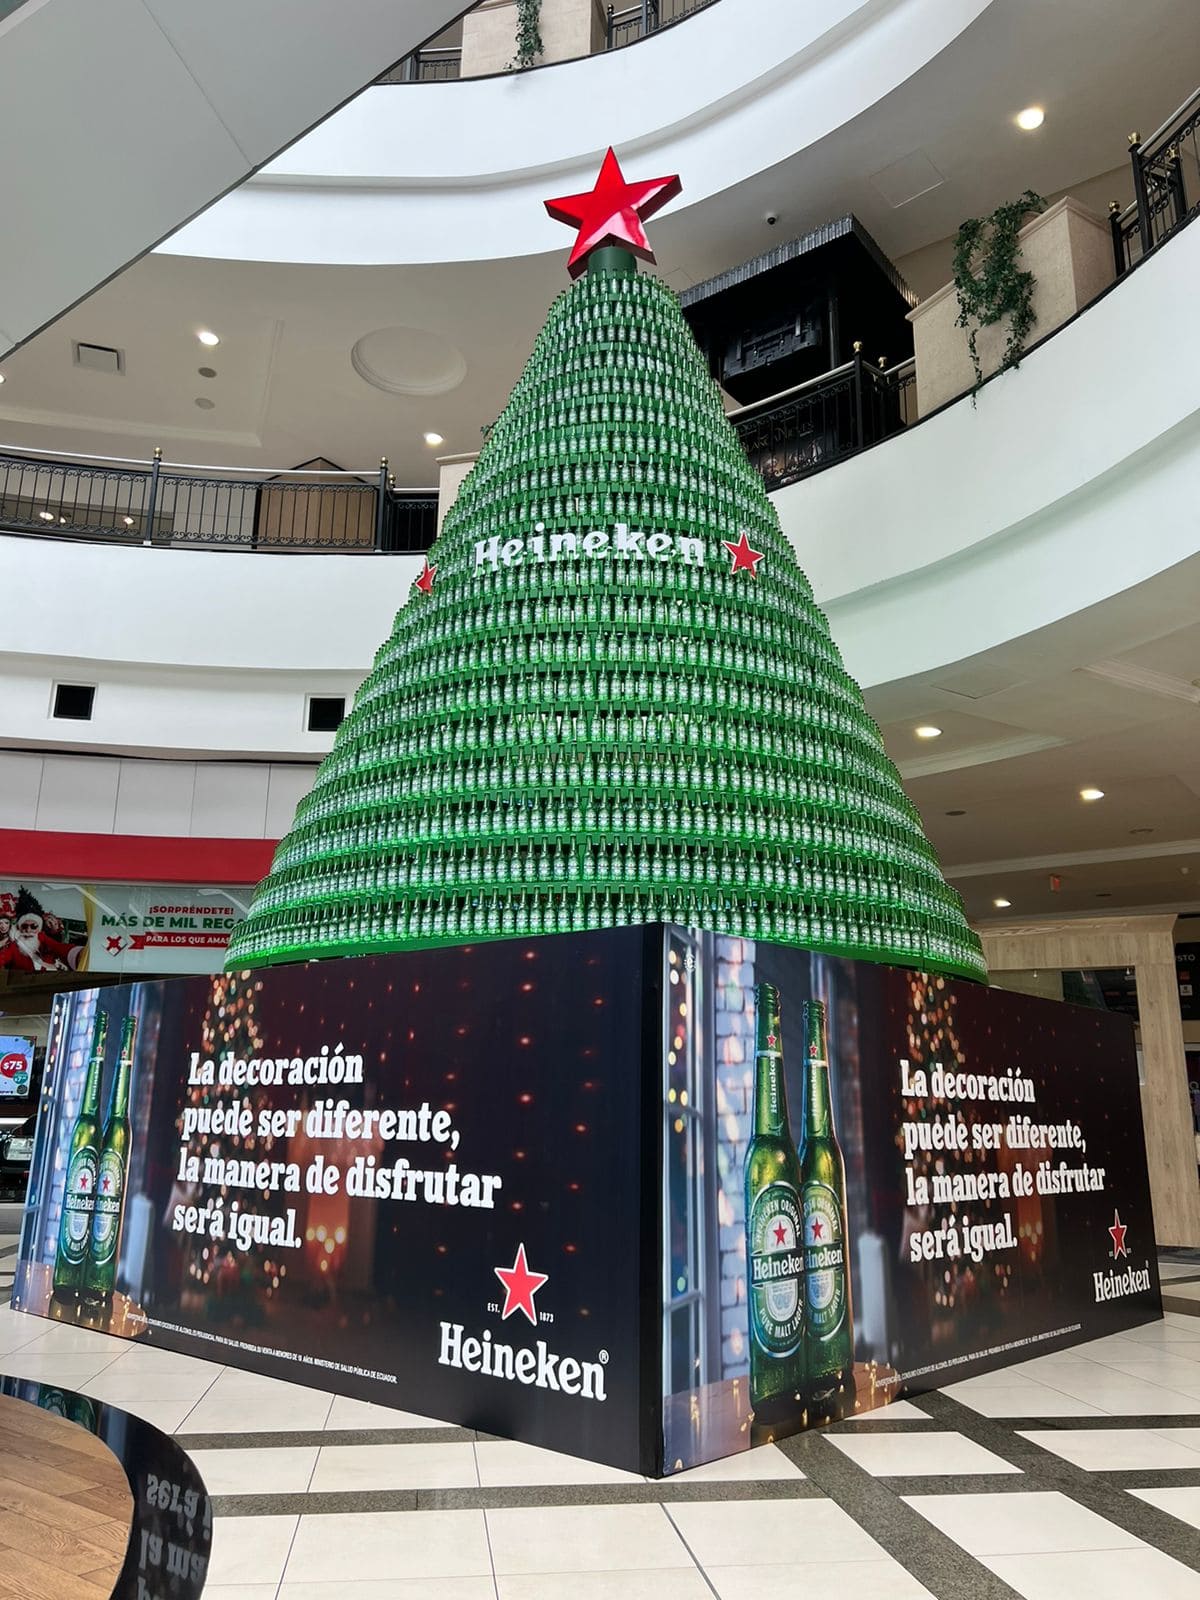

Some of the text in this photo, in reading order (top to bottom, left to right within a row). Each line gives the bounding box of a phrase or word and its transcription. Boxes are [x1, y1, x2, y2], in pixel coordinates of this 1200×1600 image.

[473, 522, 704, 577] Heineken
[101, 913, 138, 927] MÁS
[143, 916, 165, 928] DE
[170, 917, 198, 929] MIL
[146, 935, 168, 943] PARA
[170, 936, 187, 944] LOS
[188, 937, 205, 945] QUE
[3, 1060, 23, 1071] $75
[188, 1042, 363, 1086] La decoración
[900, 1059, 1036, 1103] La decoración
[181, 1098, 461, 1151] puede ser diferente,
[903, 1114, 1087, 1160] puede ser diferente,
[177, 1147, 502, 1209] la manera de disfrutar
[905, 1160, 1106, 1206] la manera de disfrutar
[172, 1197, 302, 1251] será igual.
[910, 1213, 1018, 1264] será igual.
[1093, 1265, 1151, 1303] Heineken
[487, 1302, 501, 1313] EST.
[540, 1311, 554, 1323] 1873
